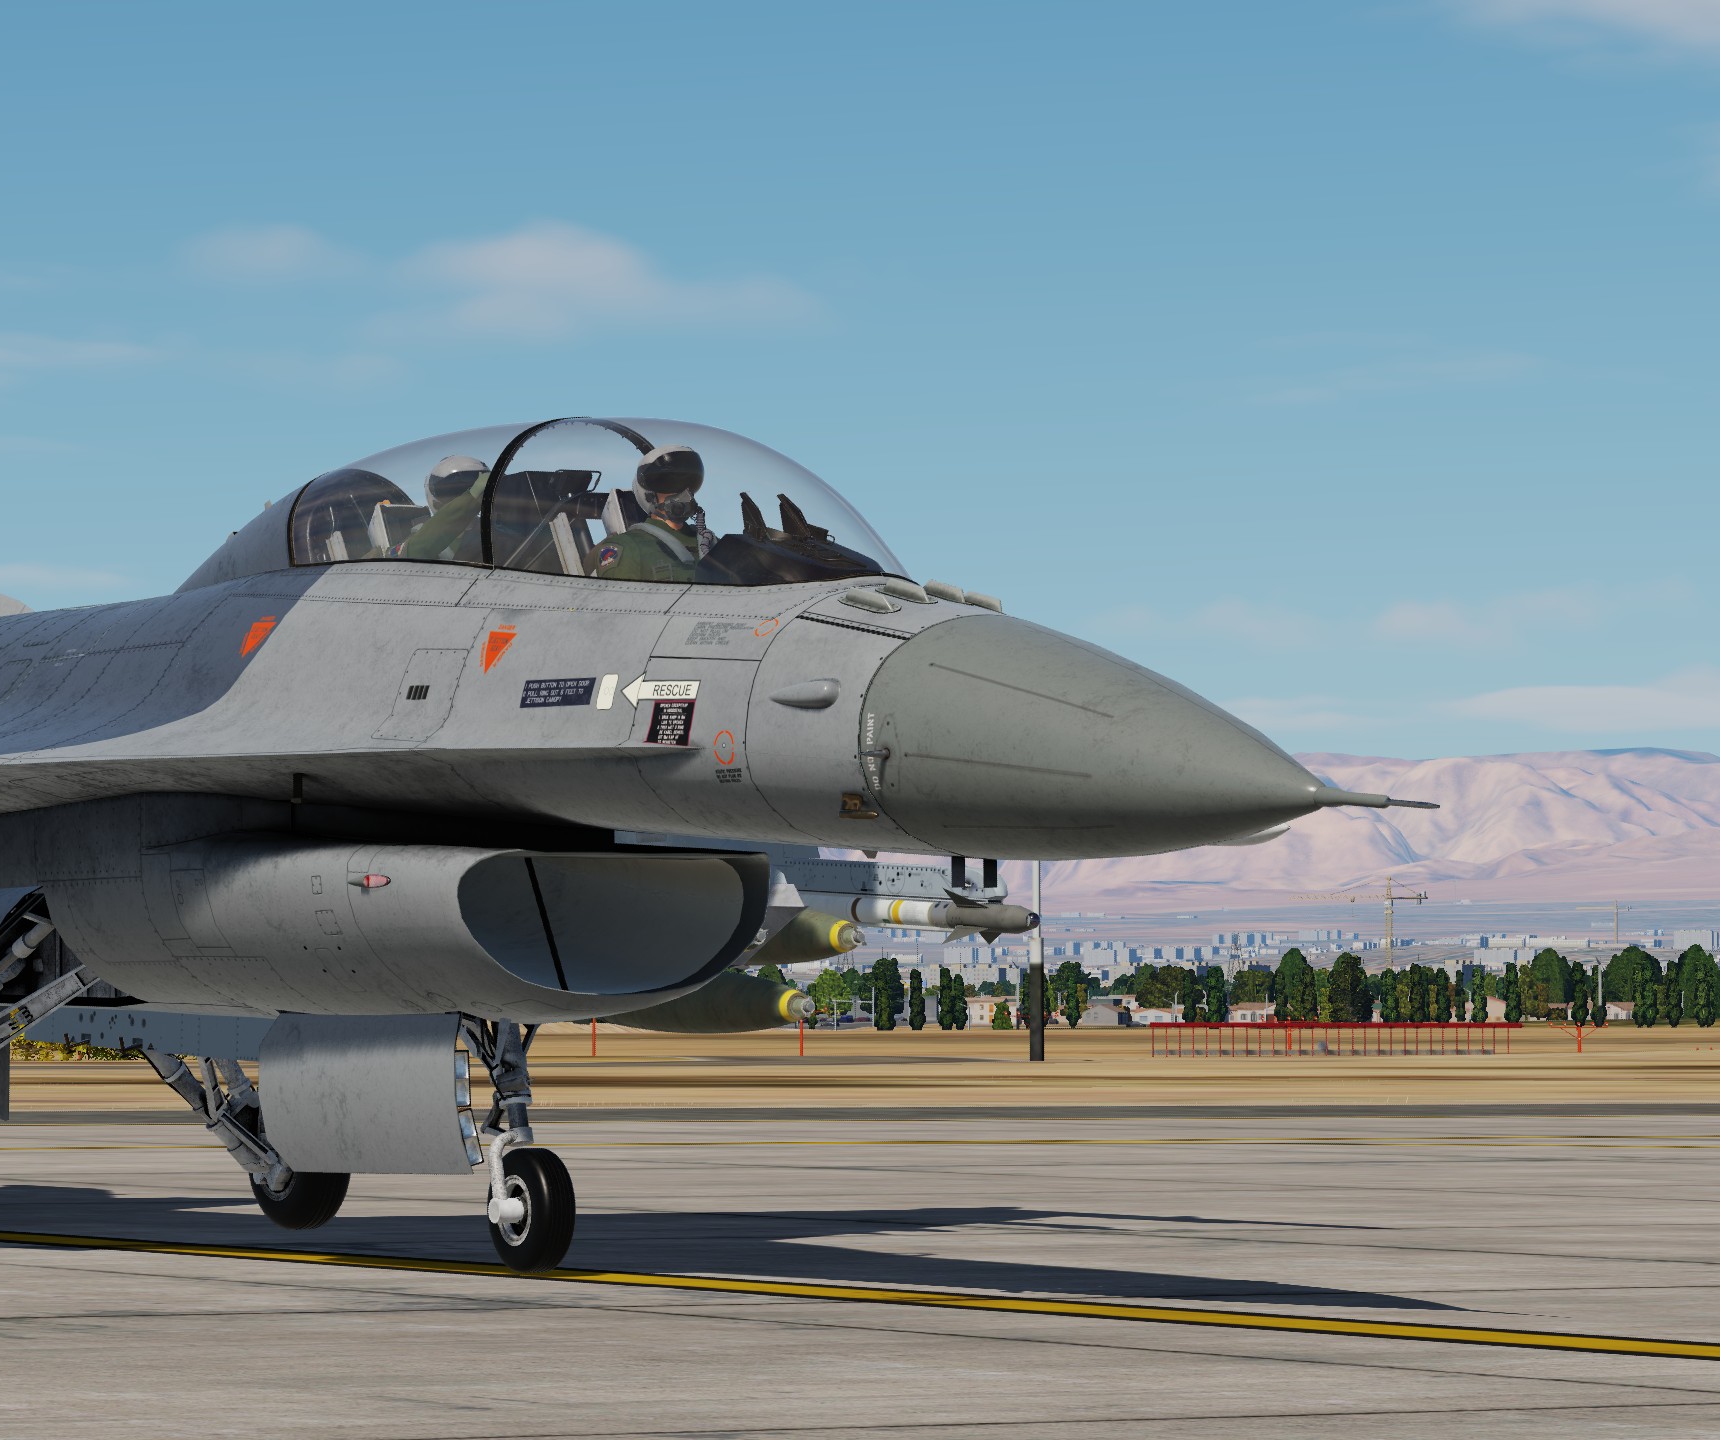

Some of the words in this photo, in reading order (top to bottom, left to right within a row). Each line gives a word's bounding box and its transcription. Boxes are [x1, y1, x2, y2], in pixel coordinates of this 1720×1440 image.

[540, 681, 557, 689] BUTTON
[652, 684, 692, 697] RESCUE
[866, 712, 875, 745] PAINT
[872, 775, 881, 790] DO
